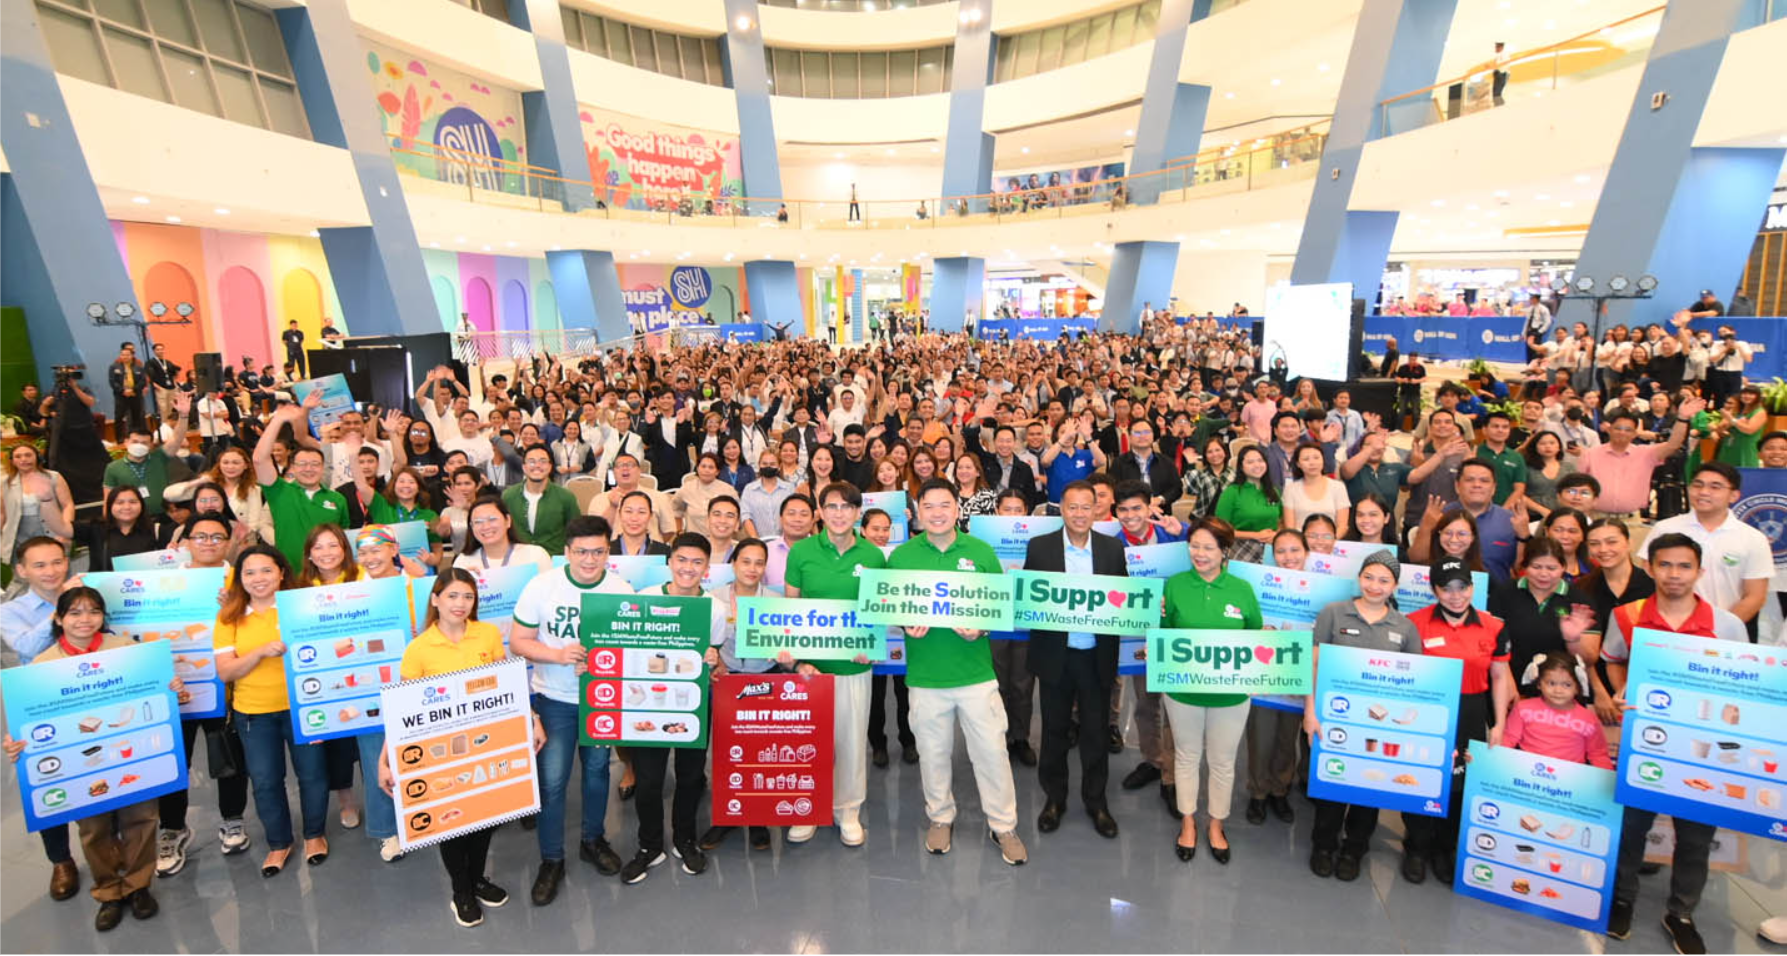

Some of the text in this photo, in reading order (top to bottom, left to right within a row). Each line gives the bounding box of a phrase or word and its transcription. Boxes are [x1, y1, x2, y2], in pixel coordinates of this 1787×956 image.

[607, 124, 716, 166] Good things
[628, 152, 696, 183] happen
[1442, 561, 1461, 570] KFC
[877, 581, 1010, 601] Be the Solution
[1015, 577, 1024, 601] I
[1262, 592, 1277, 601] Bin
[555, 606, 580, 622] SP
[860, 598, 1002, 619] Join the Mission
[611, 621, 681, 633] BIN IT RIGHT!
[748, 608, 874, 629] I care for th
[1014, 610, 1151, 629] #SMWasteFreeFuture
[547, 620, 580, 638] HA
[746, 628, 876, 649] Environment
[1156, 637, 1164, 662] I
[1369, 658, 1391, 668] KFC
[1688, 662, 1759, 681] Bin it right!
[60, 676, 124, 696] Bin it right!
[1157, 672, 1303, 687] #SMWasteFreeFuture
[1361, 671, 1378, 680] Bin
[1387, 675, 1415, 686] right!
[421, 693, 451, 706] CARES
[780, 692, 808, 700] CARES
[402, 692, 515, 728] WE BIN IT RIGHT!
[736, 710, 811, 721] BIN IT RIGHT!
[1520, 709, 1596, 736] adidas
[1513, 777, 1573, 798] Bin it right!
